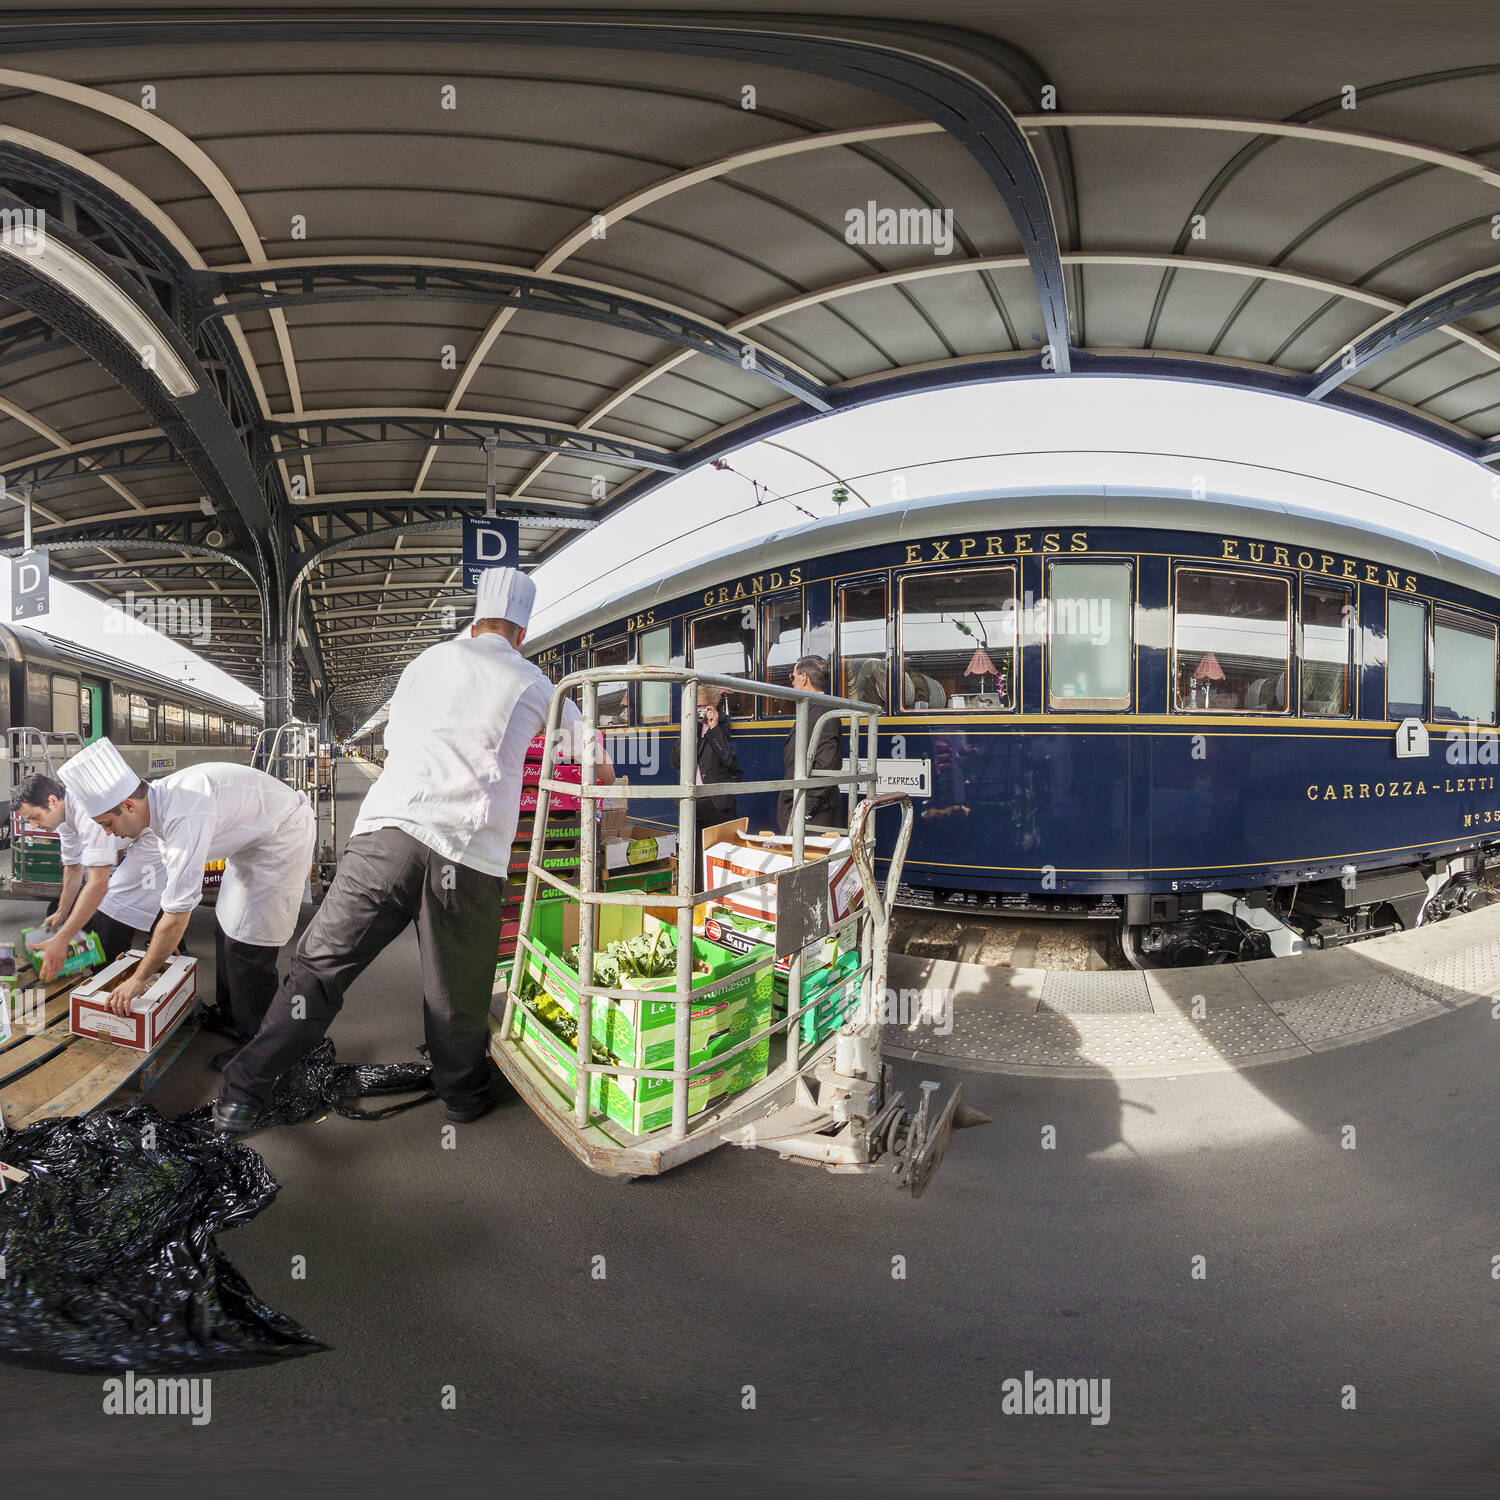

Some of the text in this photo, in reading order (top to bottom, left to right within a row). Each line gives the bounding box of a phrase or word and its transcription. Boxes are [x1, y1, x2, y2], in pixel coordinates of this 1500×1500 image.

[476, 528, 507, 561] D
[19, 564, 41, 594] D
[580, 632, 596, 649] ET
[626, 610, 656, 632] DES
[703, 567, 804, 607] GRANDS
[905, 532, 1090, 565] EXPRESS
[1221, 539, 1418, 592] EUROPEENS
[1407, 726, 1418, 751] F
[1171, 881, 1178, 891] 5
